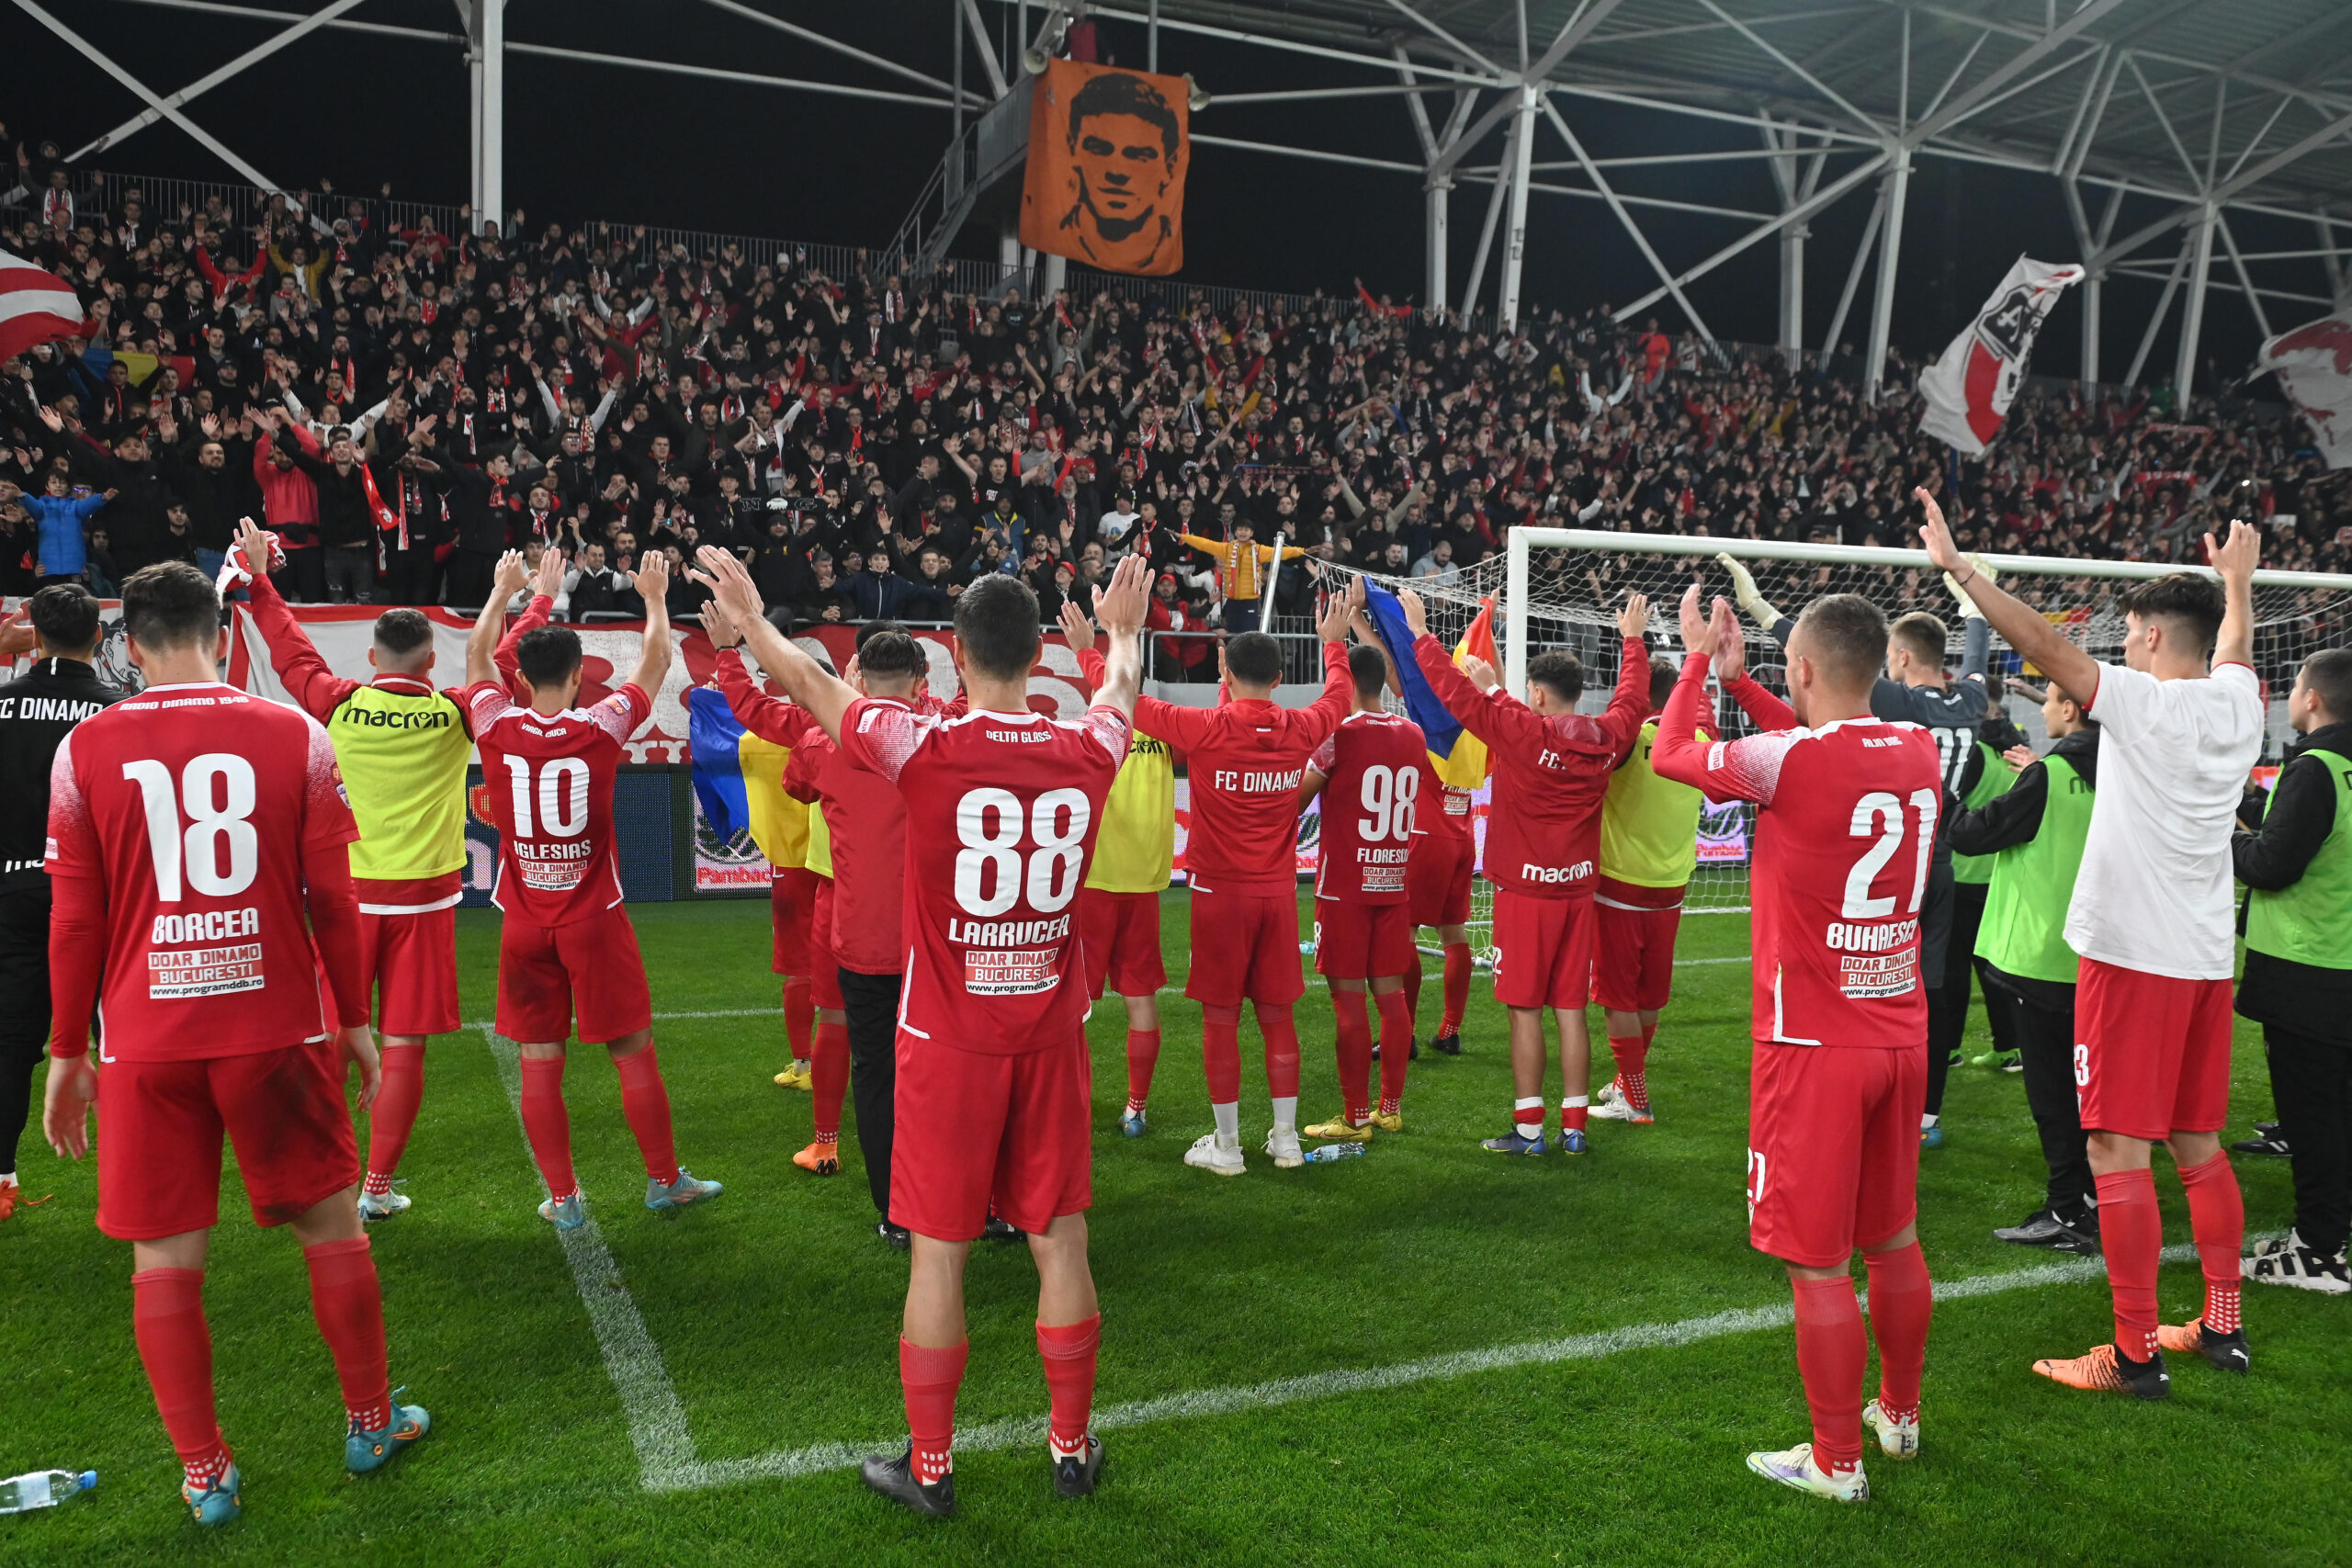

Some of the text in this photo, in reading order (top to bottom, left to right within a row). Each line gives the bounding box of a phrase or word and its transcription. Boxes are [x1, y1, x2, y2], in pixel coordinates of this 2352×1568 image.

[119, 695, 250, 711] RADIO DINAMO 1948
[342, 707, 449, 728] macron
[521, 723, 543, 737] VIRGIL
[986, 730, 1052, 743] DELTA GLASS
[1538, 749, 1560, 769] FC
[1215, 768, 1302, 792] FC DINAMO
[503, 753, 590, 838] 10
[1358, 764, 1419, 841] 98
[122, 752, 258, 901] 18
[514, 840, 592, 860] IGLESIAS
[954, 787, 1091, 917] 88
[1841, 787, 1939, 919] 21
[521, 861, 585, 872] DOAR DINAMO
[1364, 867, 1385, 876] DOAR
[1521, 860, 1593, 883] macron
[526, 872, 582, 882] BUCURESTI
[152, 907, 259, 944] BORCEA
[948, 914, 1070, 946] LARRUCEA
[151, 945, 259, 967] DOAR DINAMO
[967, 949, 1056, 965] DOAR DINAMO
[1842, 949, 1915, 971] DOAR DINAMO
[159, 964, 254, 984] BUCURESTI
[975, 966, 1049, 981] BUCURESTI
[1848, 967, 1911, 986] BUCURESTI
[151, 978, 263, 996] www.programddb.ro
[967, 977, 1058, 993] www.programddb.ro
[2074, 1043, 2089, 1086] 3
[2254, 1247, 2350, 1282] AIR
